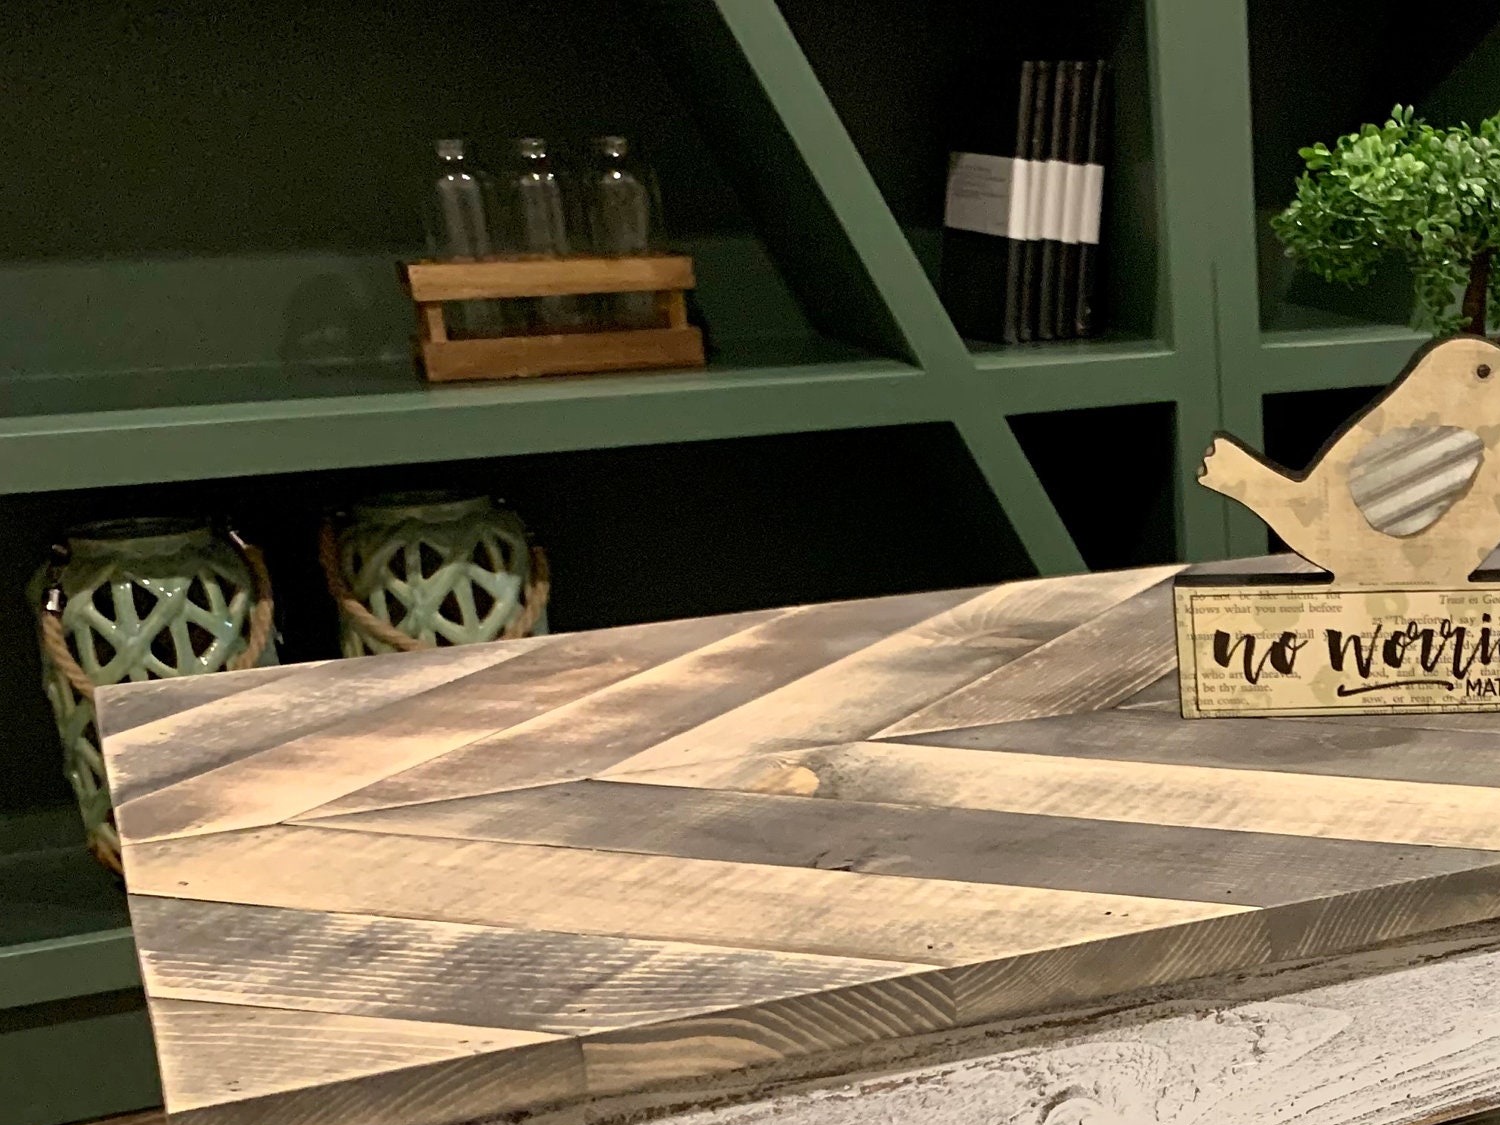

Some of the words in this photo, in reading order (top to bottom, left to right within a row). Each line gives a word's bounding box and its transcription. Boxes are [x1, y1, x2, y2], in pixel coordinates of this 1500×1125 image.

[1223, 604, 1251, 614] what
[1255, 606, 1277, 615] you
[1308, 602, 1343, 613] before
[1459, 616, 1476, 626] say
[1213, 629, 1308, 685] no
[1202, 669, 1226, 679] who
[1203, 684, 1215, 692] be
[1219, 684, 1236, 695] thy
